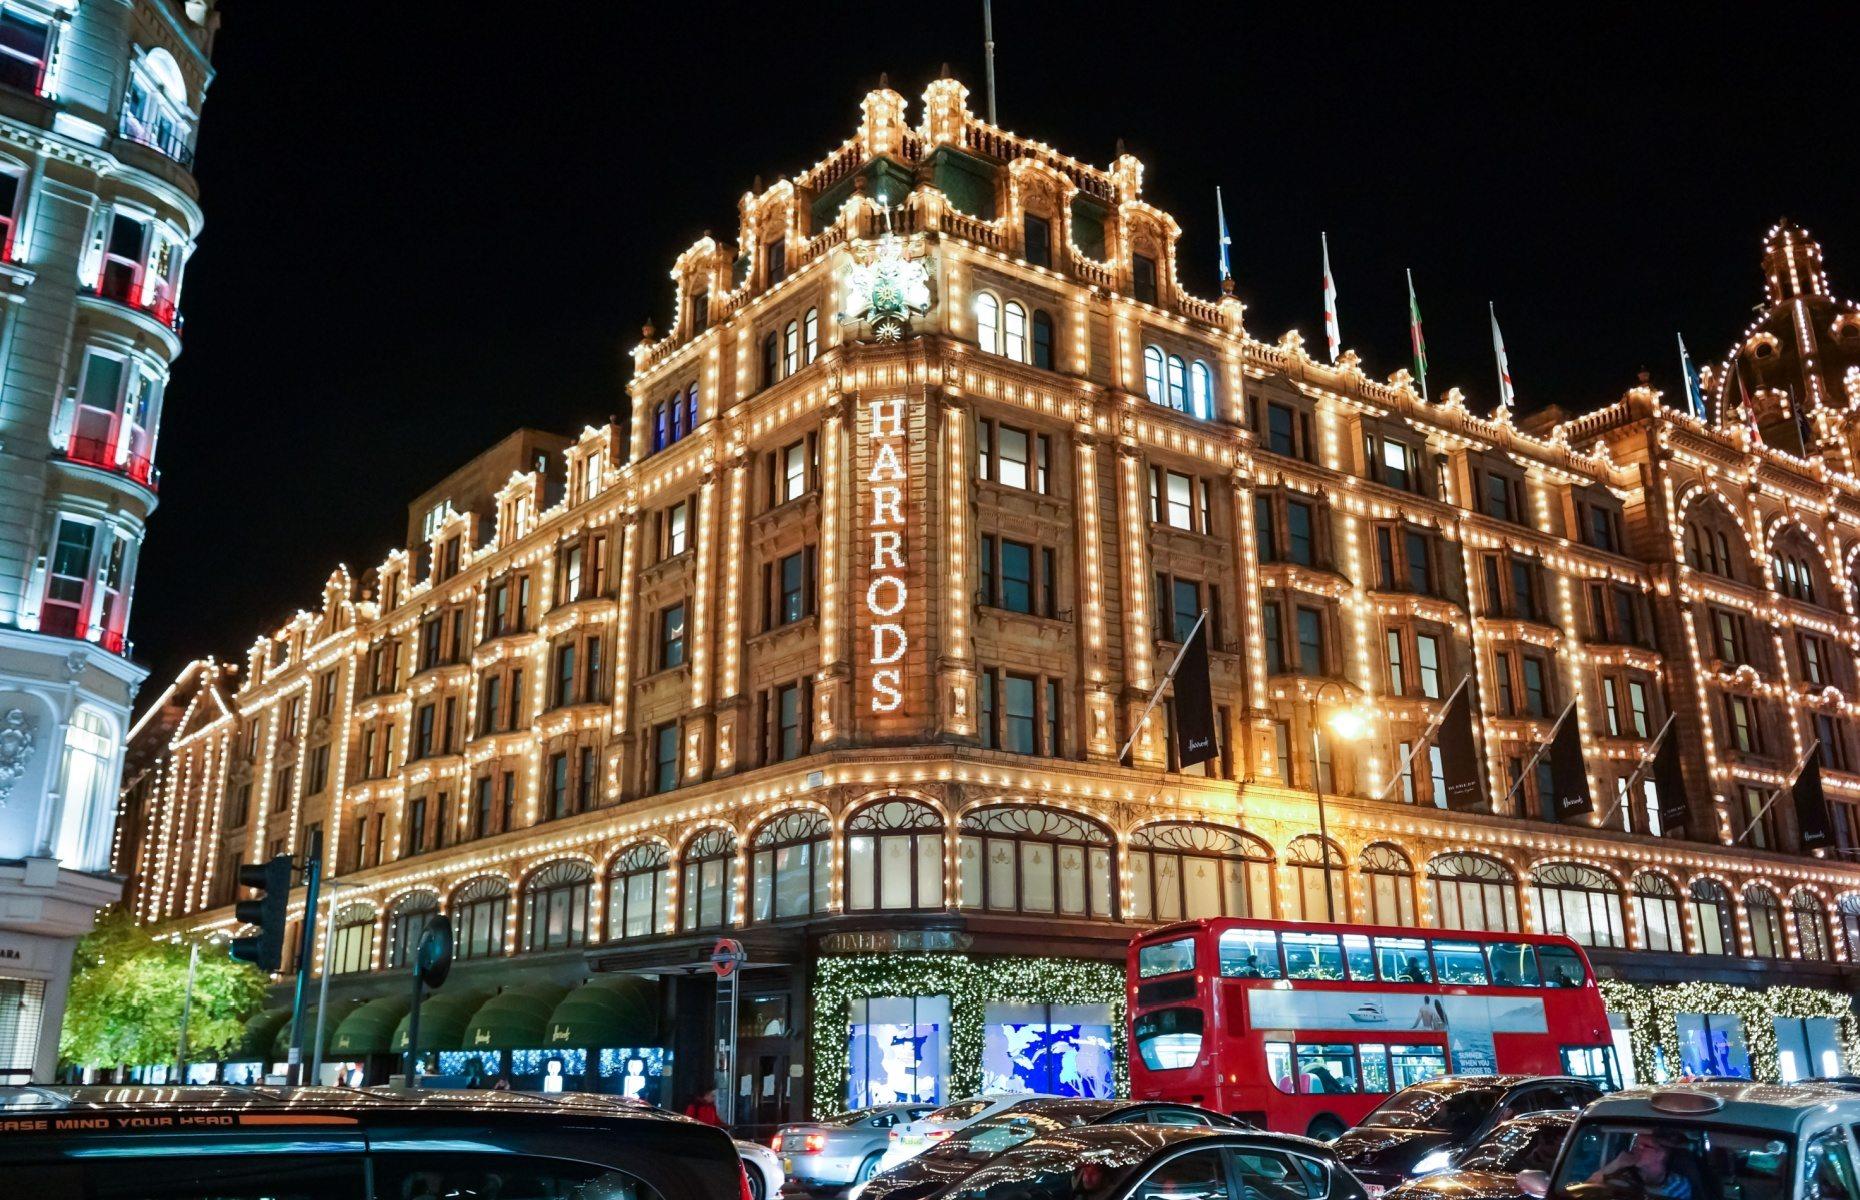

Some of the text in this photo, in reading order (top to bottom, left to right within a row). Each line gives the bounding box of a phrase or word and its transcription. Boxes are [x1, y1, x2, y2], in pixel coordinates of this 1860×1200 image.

[867, 399, 908, 712] HARRODS
[1458, 1051, 1483, 1059] SUMMER
[1460, 1059, 1490, 1067] WHEN YOU
[55, 1118, 110, 1129] MIND
[118, 1117, 173, 1128] YOUR
[179, 1116, 234, 1126] HEAD
